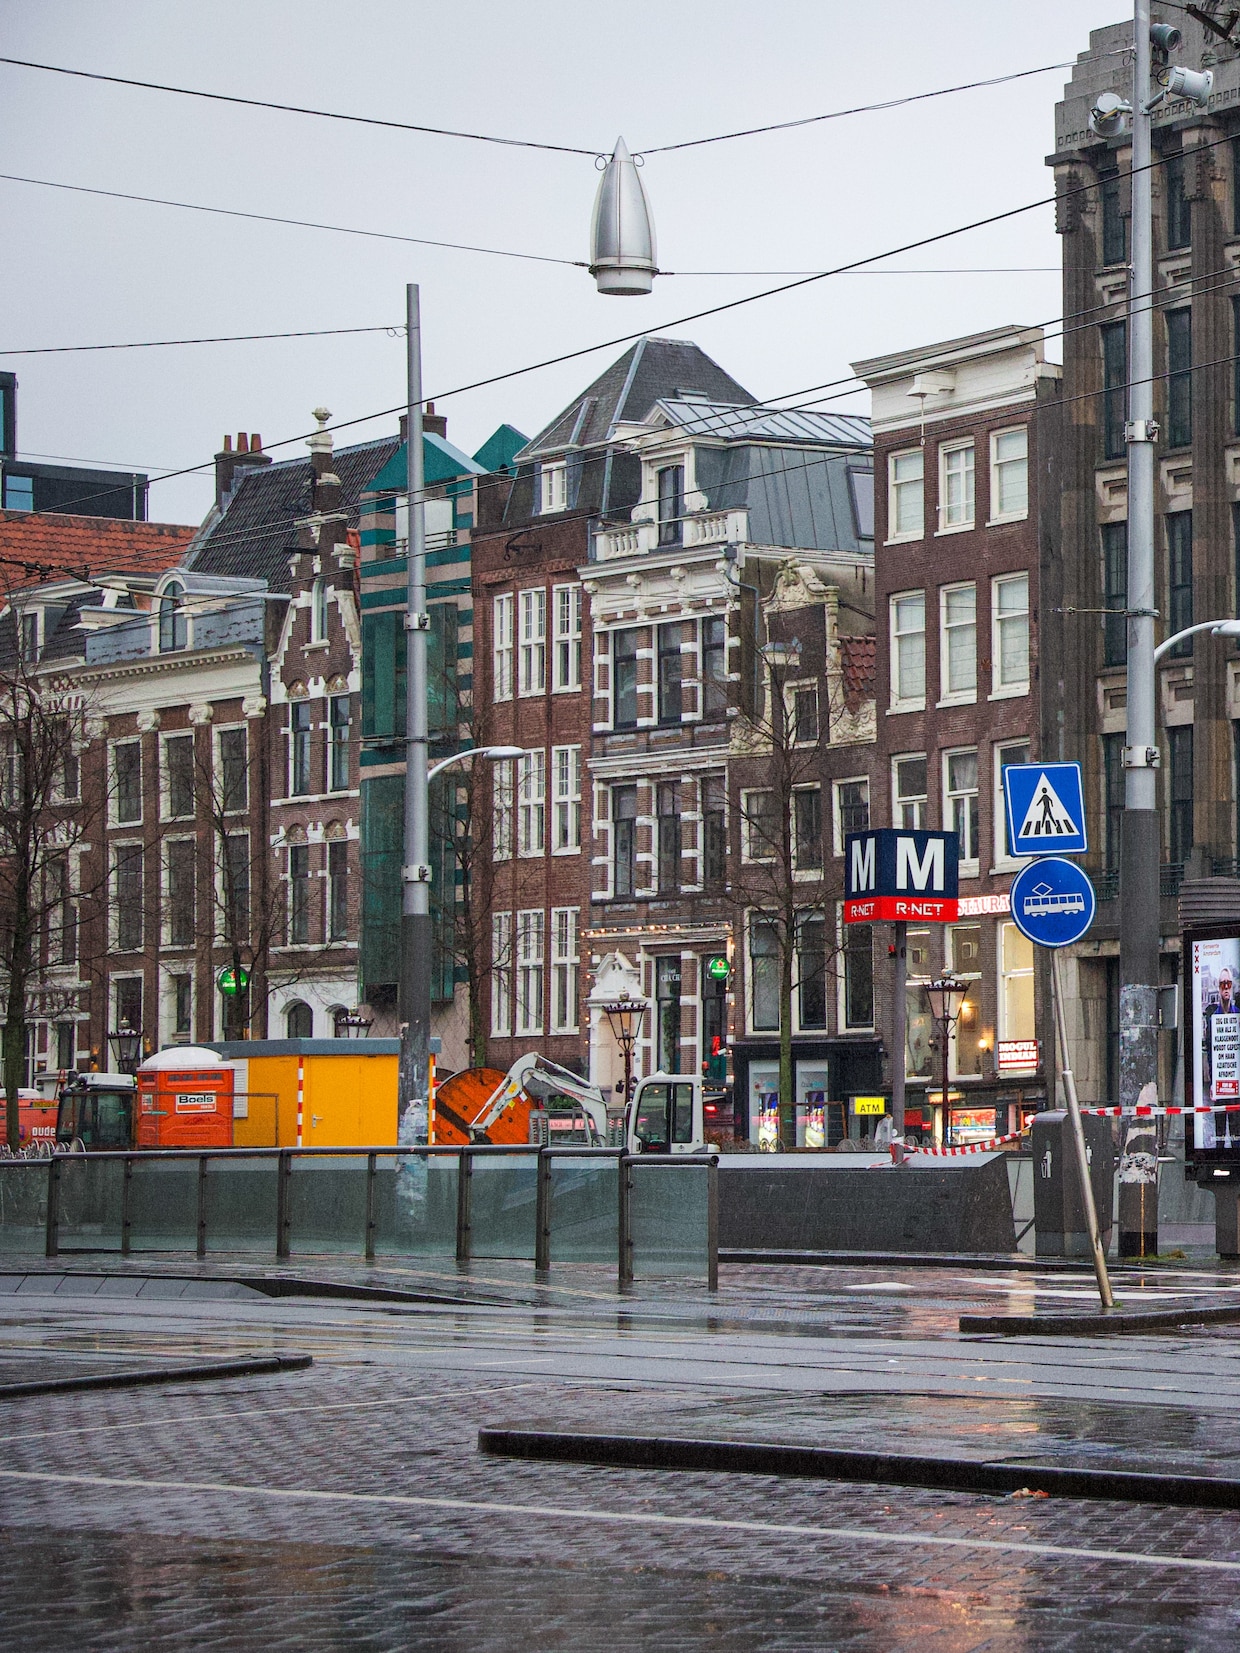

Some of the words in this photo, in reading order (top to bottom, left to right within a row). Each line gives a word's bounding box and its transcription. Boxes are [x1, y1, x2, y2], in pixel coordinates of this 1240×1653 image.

[851, 837, 876, 893] M
[896, 836, 945, 891] M
[958, 894, 1011, 916] STAURA
[998, 1042, 1036, 1052] MOGUL
[178, 1093, 215, 1104] Boels
[860, 1104, 880, 1113] ATM
[32, 1126, 56, 1137] oude
